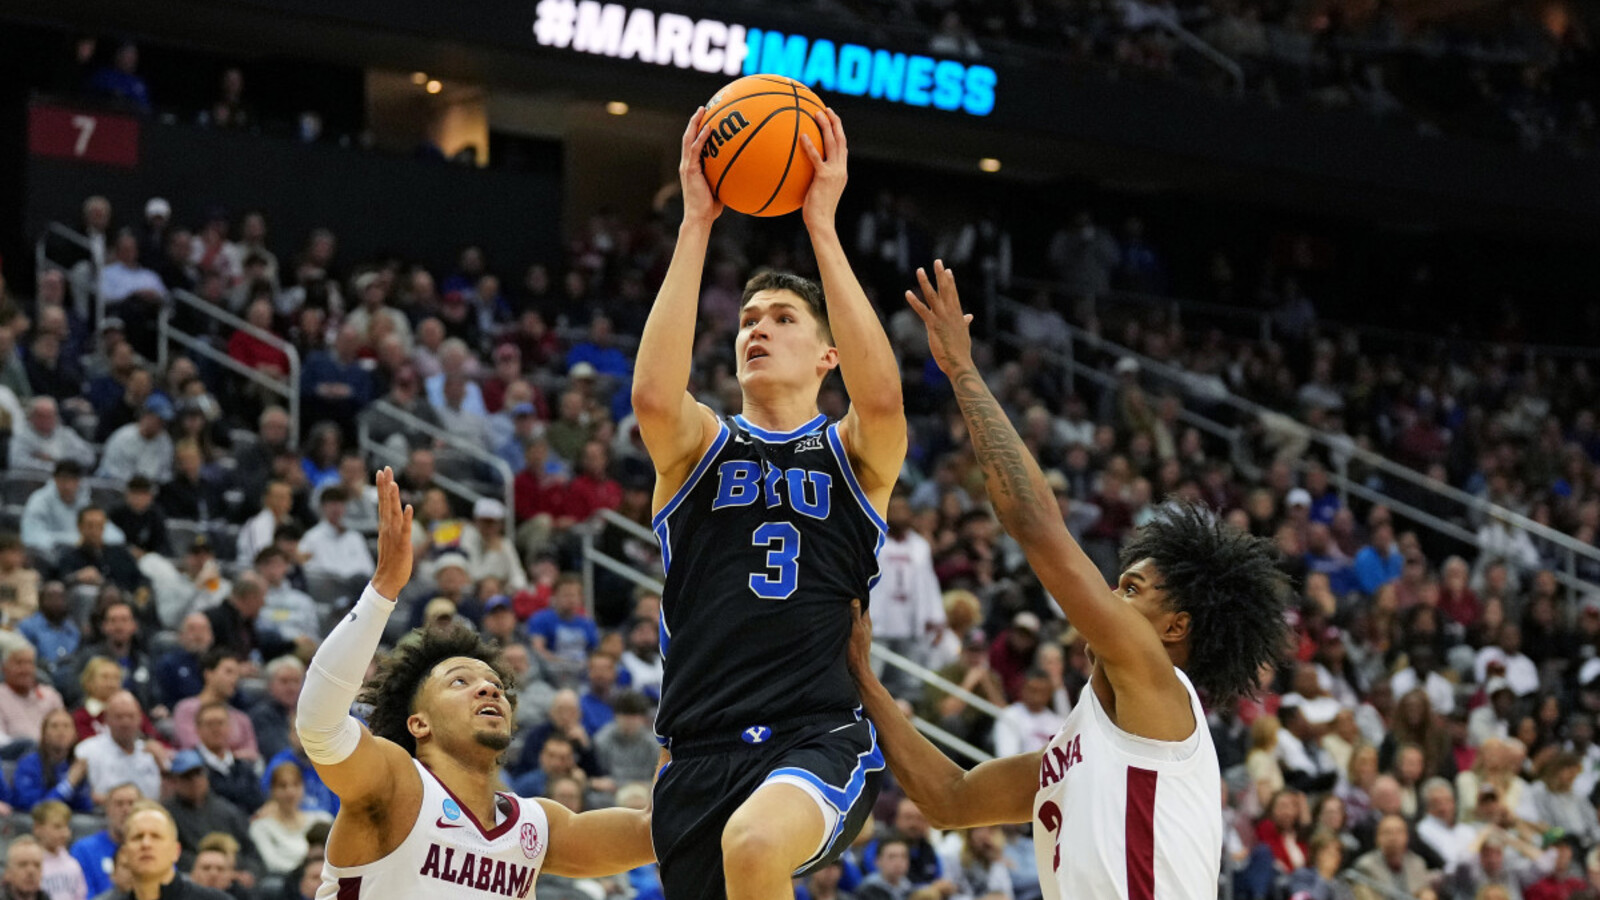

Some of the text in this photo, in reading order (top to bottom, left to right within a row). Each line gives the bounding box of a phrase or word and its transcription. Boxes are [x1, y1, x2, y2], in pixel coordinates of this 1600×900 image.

[72, 115, 97, 156] 7
[712, 459, 833, 520] BYU
[749, 521, 800, 600] 3
[746, 725, 767, 743] Y
